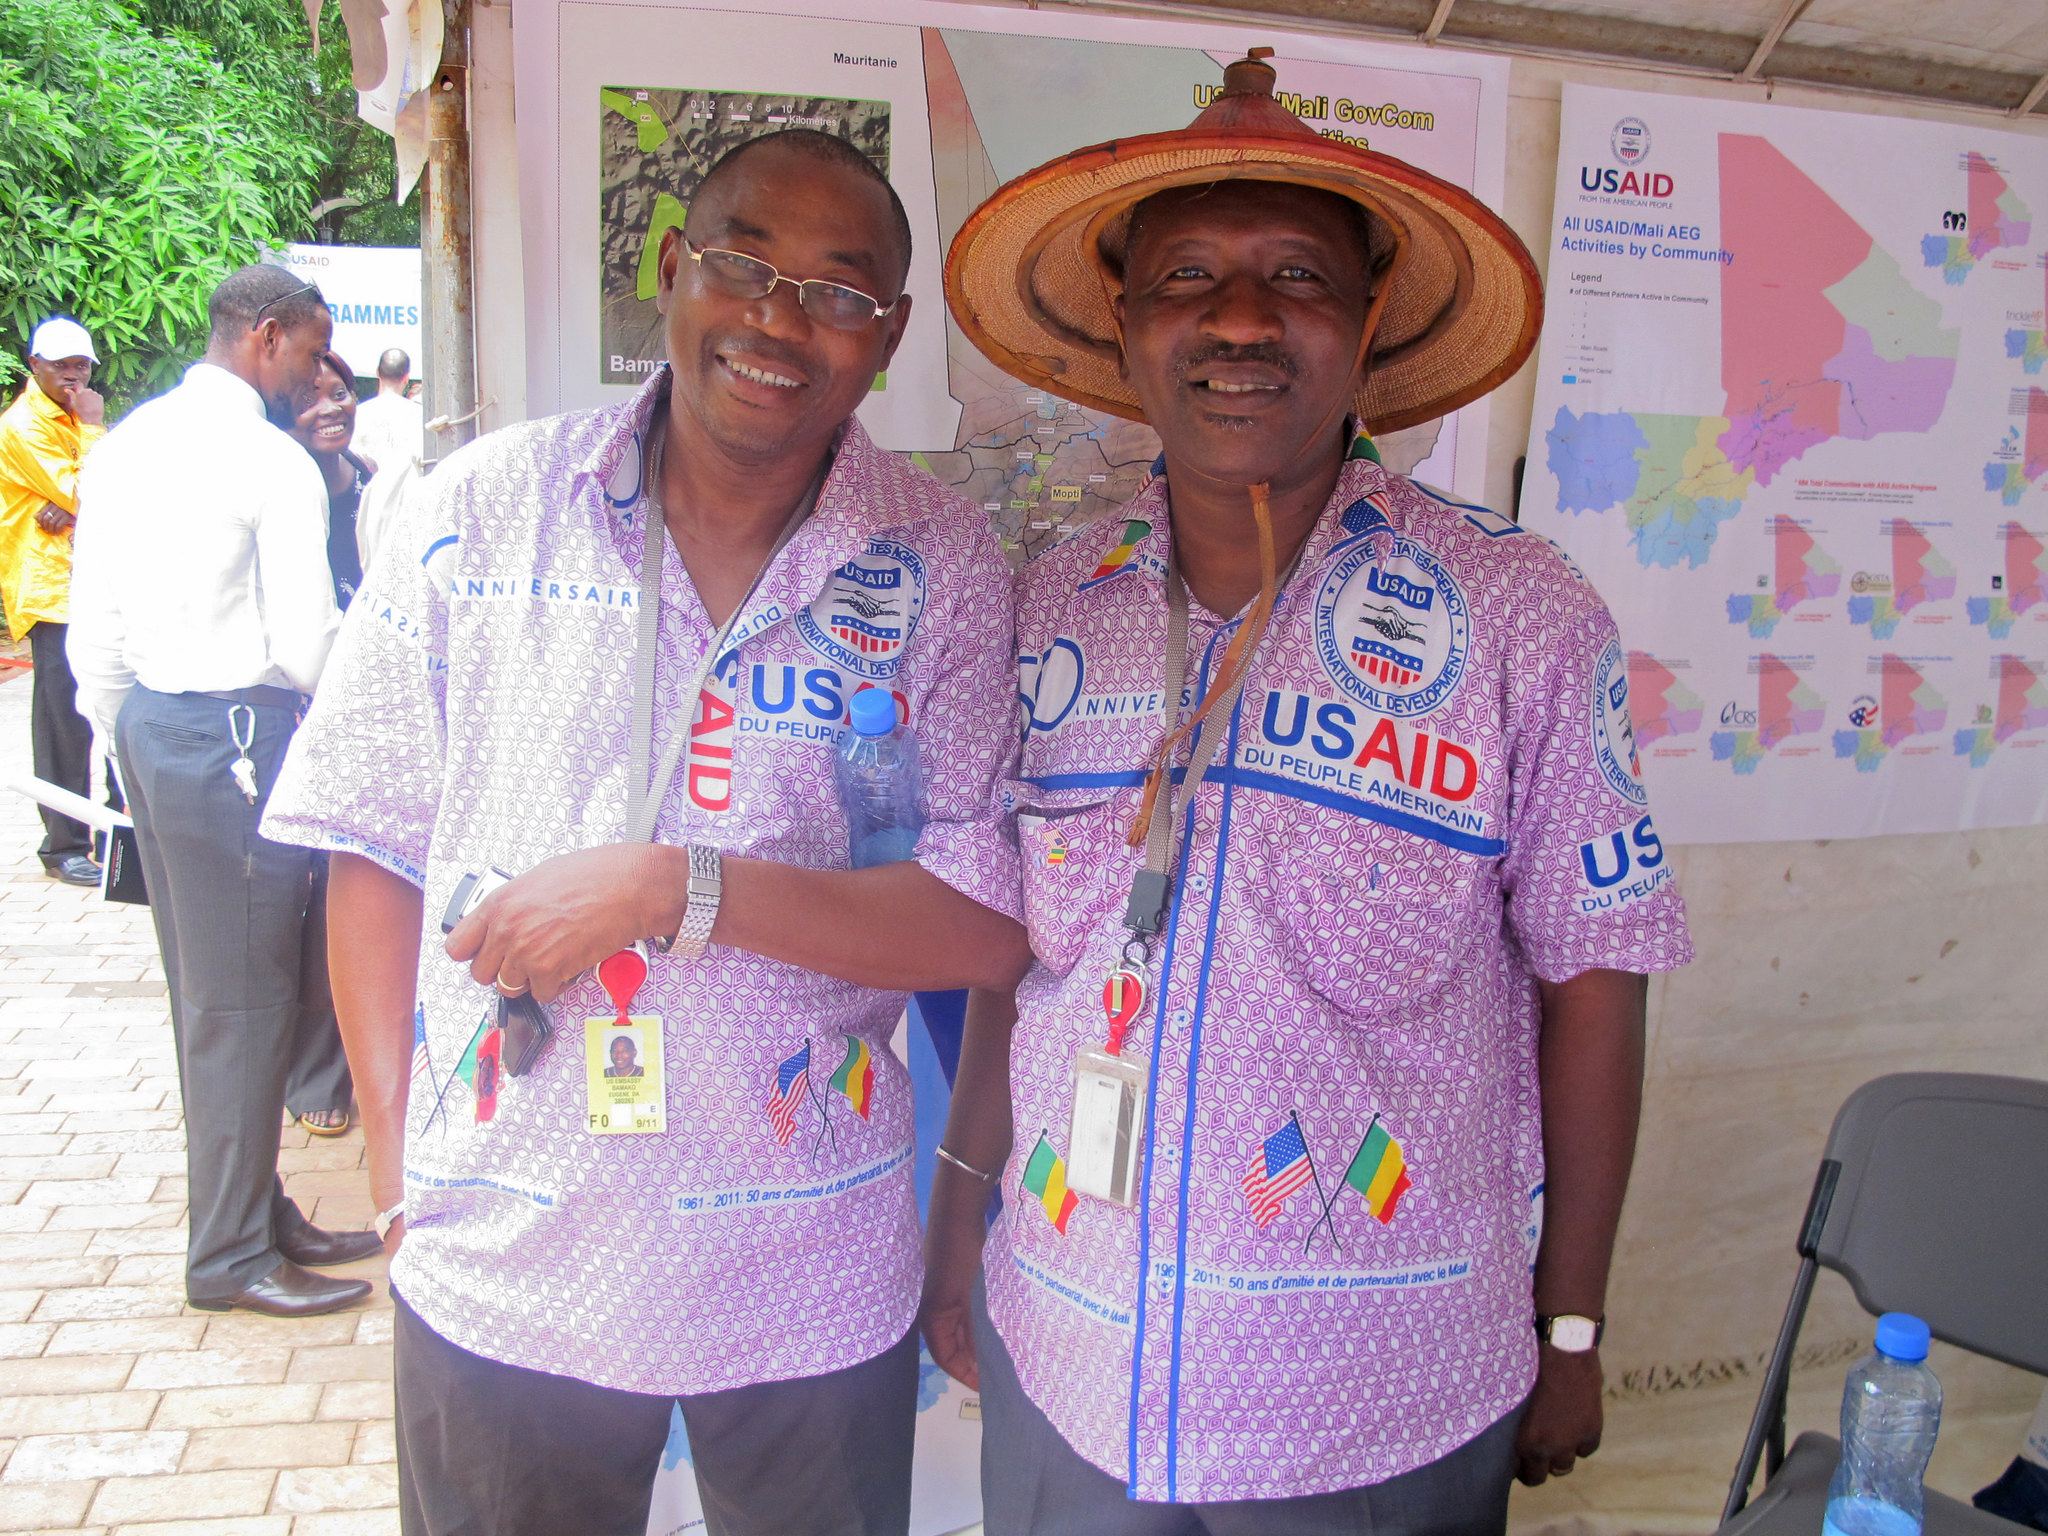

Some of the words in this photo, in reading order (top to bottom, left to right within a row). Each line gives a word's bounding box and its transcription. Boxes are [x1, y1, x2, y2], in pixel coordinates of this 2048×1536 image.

[832, 52, 898, 69] Mauritanie
[690, 100, 697, 109] 0
[709, 100, 716, 110] 2
[727, 101, 734, 111] 4
[746, 102, 753, 111] 6
[765, 103, 772, 113] 8
[781, 104, 793, 114] 10
[1334, 98, 1434, 131] GovCom
[1580, 166, 1674, 198] USAID
[1579, 194, 1597, 203] FROM
[1599, 196, 1611, 204] THE
[1613, 198, 1647, 208] AMERICAN
[1649, 201, 1673, 210] PEOPLE
[1562, 216, 1580, 231] All
[1584, 218, 1664, 239] USAID/Mali
[1667, 225, 1701, 240] AEG
[291, 255, 330, 267] USAID
[1561, 237, 1624, 255] Activities
[1629, 242, 1647, 260] by
[1651, 244, 1734, 265] Community
[1571, 272, 1602, 283] Legend
[1582, 289, 1610, 298] Different
[1612, 291, 1640, 300] Partners
[1642, 293, 1662, 301] Active
[1672, 295, 1709, 305] Community
[326, 303, 418, 326] RAMMES
[1053, 488, 1080, 501] Mopti
[844, 564, 894, 585] USAID
[1335, 542, 1377, 580] UNITE
[1375, 576, 1427, 604] USAID
[752, 606, 782, 631] DU
[1319, 604, 1382, 709] INTERNATIONAL
[1386, 644, 1464, 713] DEVELOPMENT
[1596, 664, 1608, 718] UNITED
[739, 716, 770, 734] DU
[1733, 710, 1757, 725] CRS
[1261, 691, 1478, 802] USAID
[1244, 747, 1275, 767] DU
[1279, 754, 1364, 792] PEUPLE
[1367, 779, 1484, 833] AMERICAIN
[328, 834, 355, 847] 1961
[392, 855, 404, 869] 50
[1580, 814, 1664, 889] US
[1582, 893, 1612, 912] DU
[1618, 867, 1675, 903] PEUPL
[650, 1105, 656, 1113] E
[636, 1118, 657, 1128] 9/11
[433, 1176, 446, 1187] de
[532, 1191, 553, 1206] Mali
[676, 1196, 704, 1210] 1961
[714, 1191, 744, 1207] 2011:
[746, 1189, 760, 1202] 50
[761, 1189, 781, 1201] ans
[783, 1185, 824, 1200] d'amitié
[835, 1179, 845, 1193] de
[1154, 1263, 1176, 1279] 196
[1193, 1269, 1225, 1286] 2011:
[1228, 1276, 1244, 1290] 50
[1247, 1278, 1269, 1291] ans
[1271, 1275, 1315, 1291] d'amitié
[1318, 1276, 1330, 1288] et
[1332, 1274, 1347, 1288] de
[1349, 1272, 1409, 1290] partenariat
[1410, 1271, 1435, 1285] avec
[1437, 1267, 1446, 1280] le
[1448, 1260, 1469, 1279] Mali
[1083, 1298, 1101, 1314] avec
[1100, 1304, 1109, 1318] le
[1109, 1309, 1130, 1325] Mali
